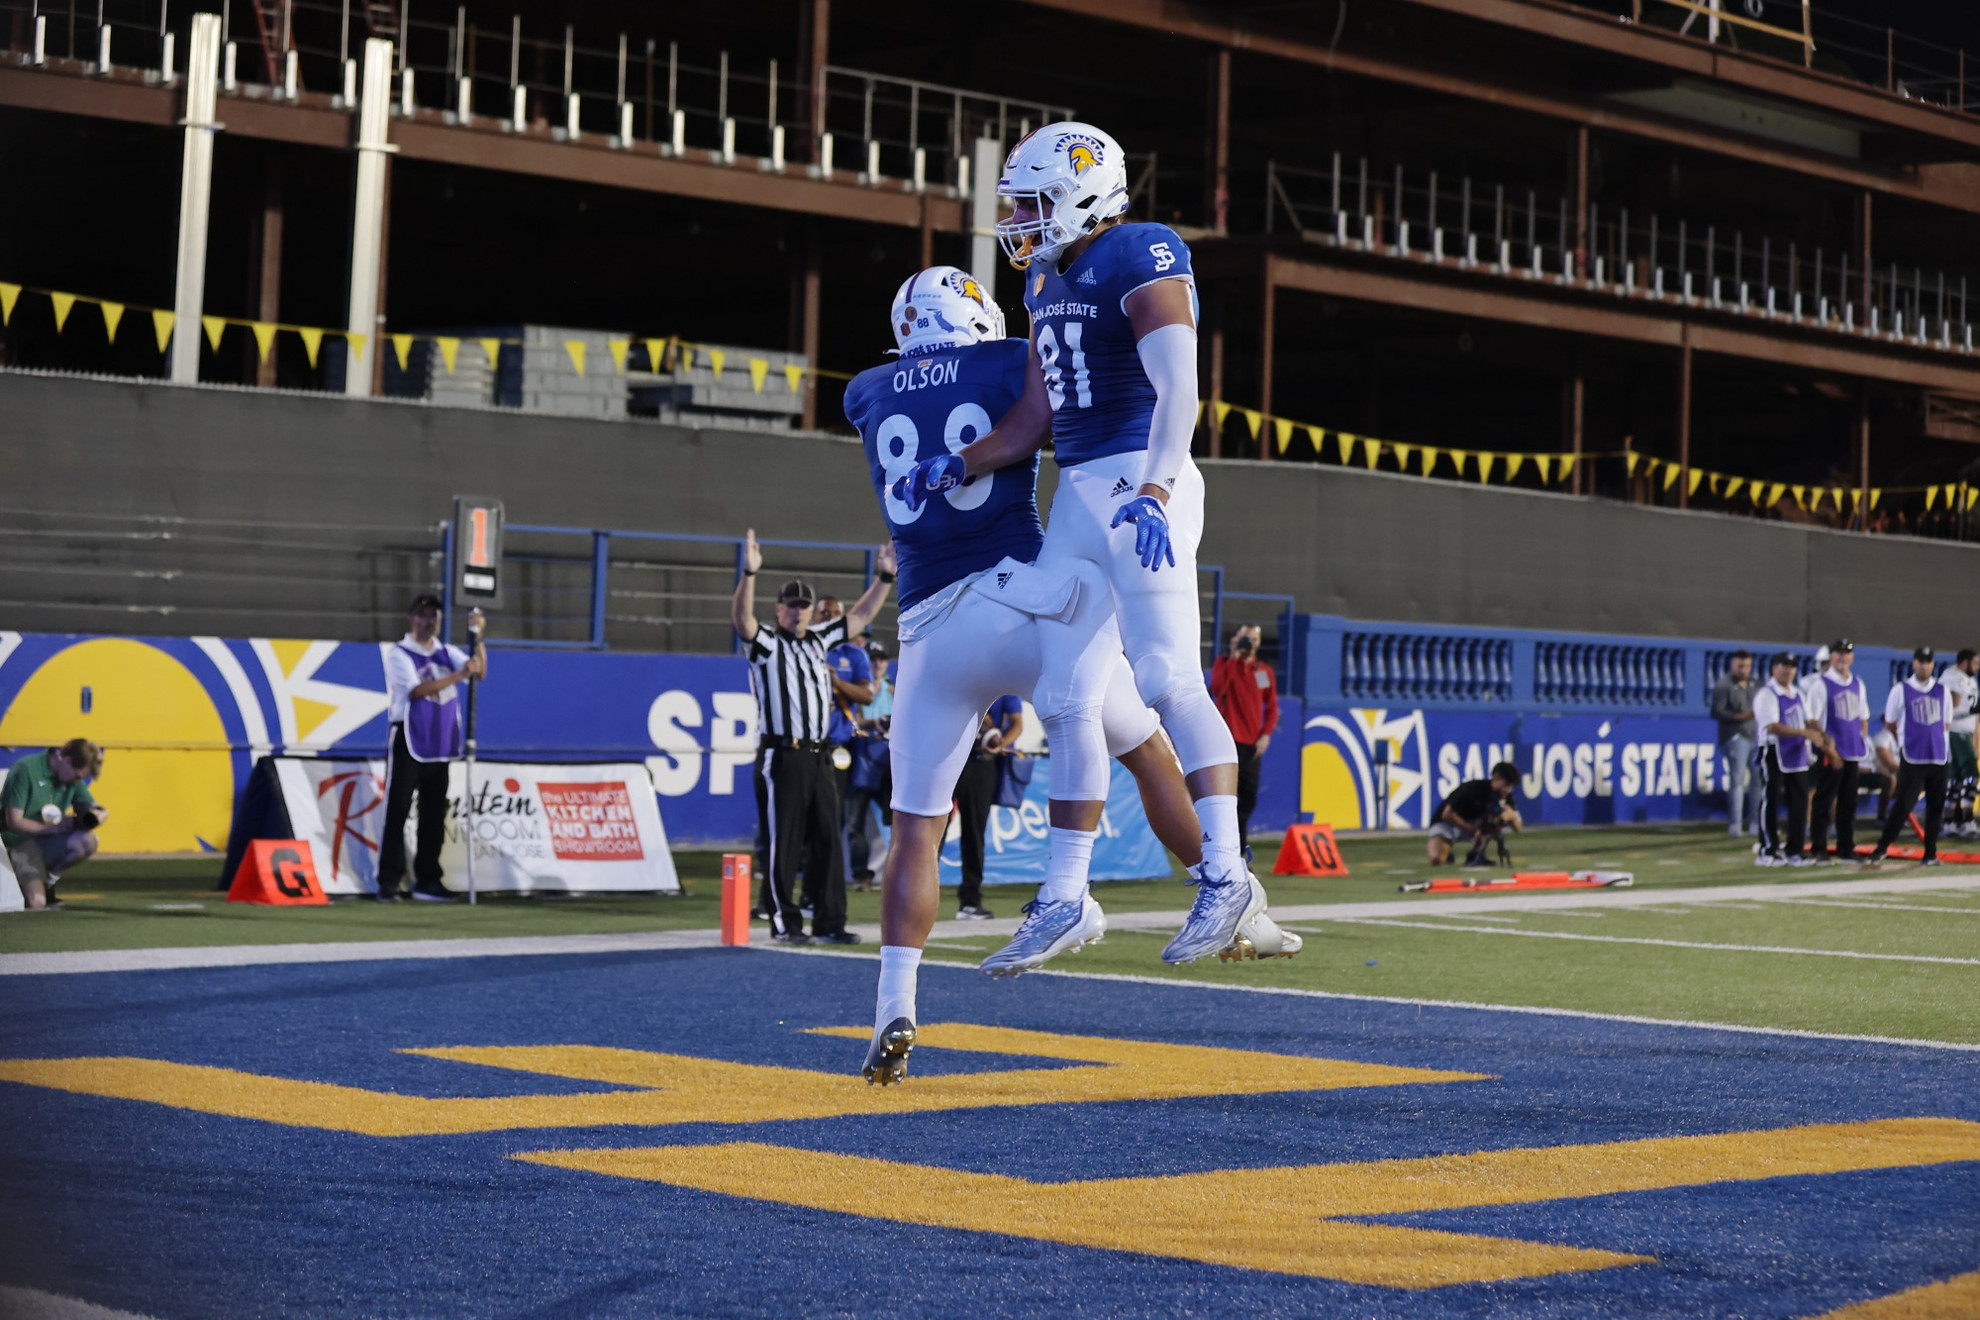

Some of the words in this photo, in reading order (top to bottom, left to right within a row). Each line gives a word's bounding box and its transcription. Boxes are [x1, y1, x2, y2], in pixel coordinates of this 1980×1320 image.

[917, 317, 930, 329] 88
[1045, 299, 1065, 318] JOSÉ
[1066, 302, 1098, 319] STATE
[893, 359, 960, 393] OLSON
[1037, 322, 1093, 411] 81
[876, 402, 994, 525] 88
[470, 508, 487, 566] 1
[1522, 720, 1613, 799] JOSÉ
[1621, 742, 1715, 797] STATE
[545, 804, 632, 820] KITCHEN
[562, 788, 628, 804] ULTIMATE
[552, 821, 586, 838] AND
[588, 821, 637, 839] BATH
[553, 839, 641, 854] SHOWROOM
[1301, 832, 1337, 870] 10
[270, 847, 313, 898] G
